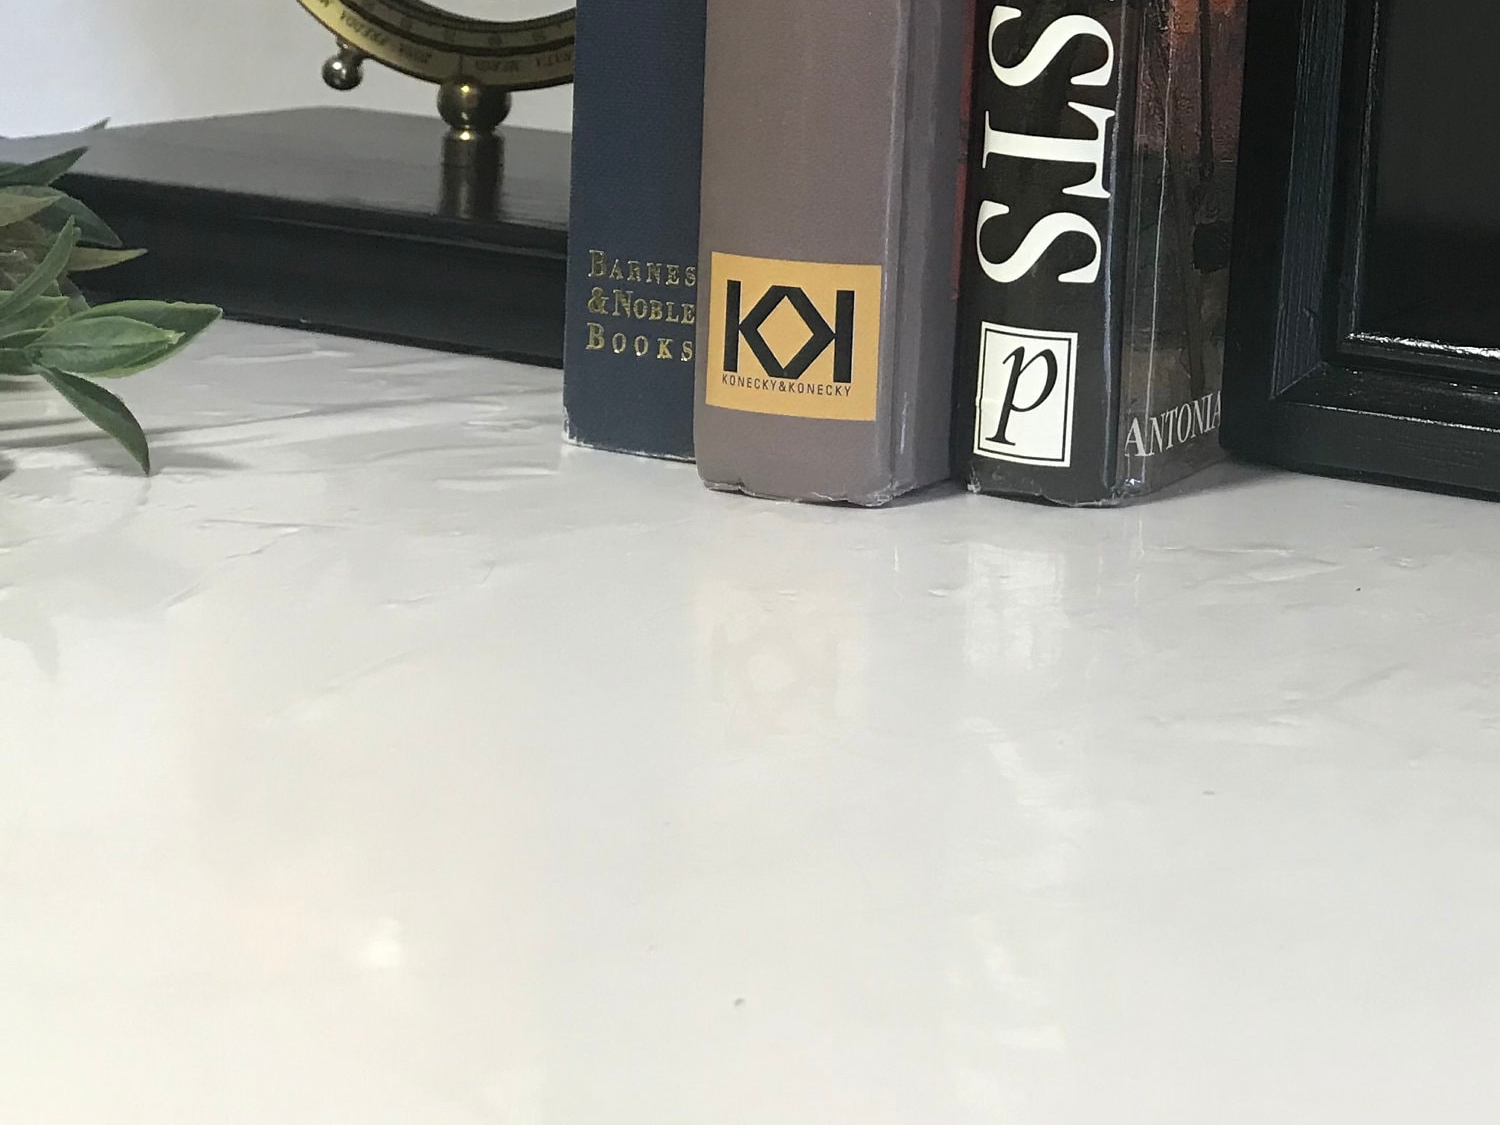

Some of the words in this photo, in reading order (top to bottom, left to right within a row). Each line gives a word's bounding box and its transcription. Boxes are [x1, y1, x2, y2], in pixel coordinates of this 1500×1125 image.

[588, 249, 697, 287] BARNES
[585, 322, 696, 362] BOOKS
[721, 373, 852, 397] KONECKY&KONECKY
